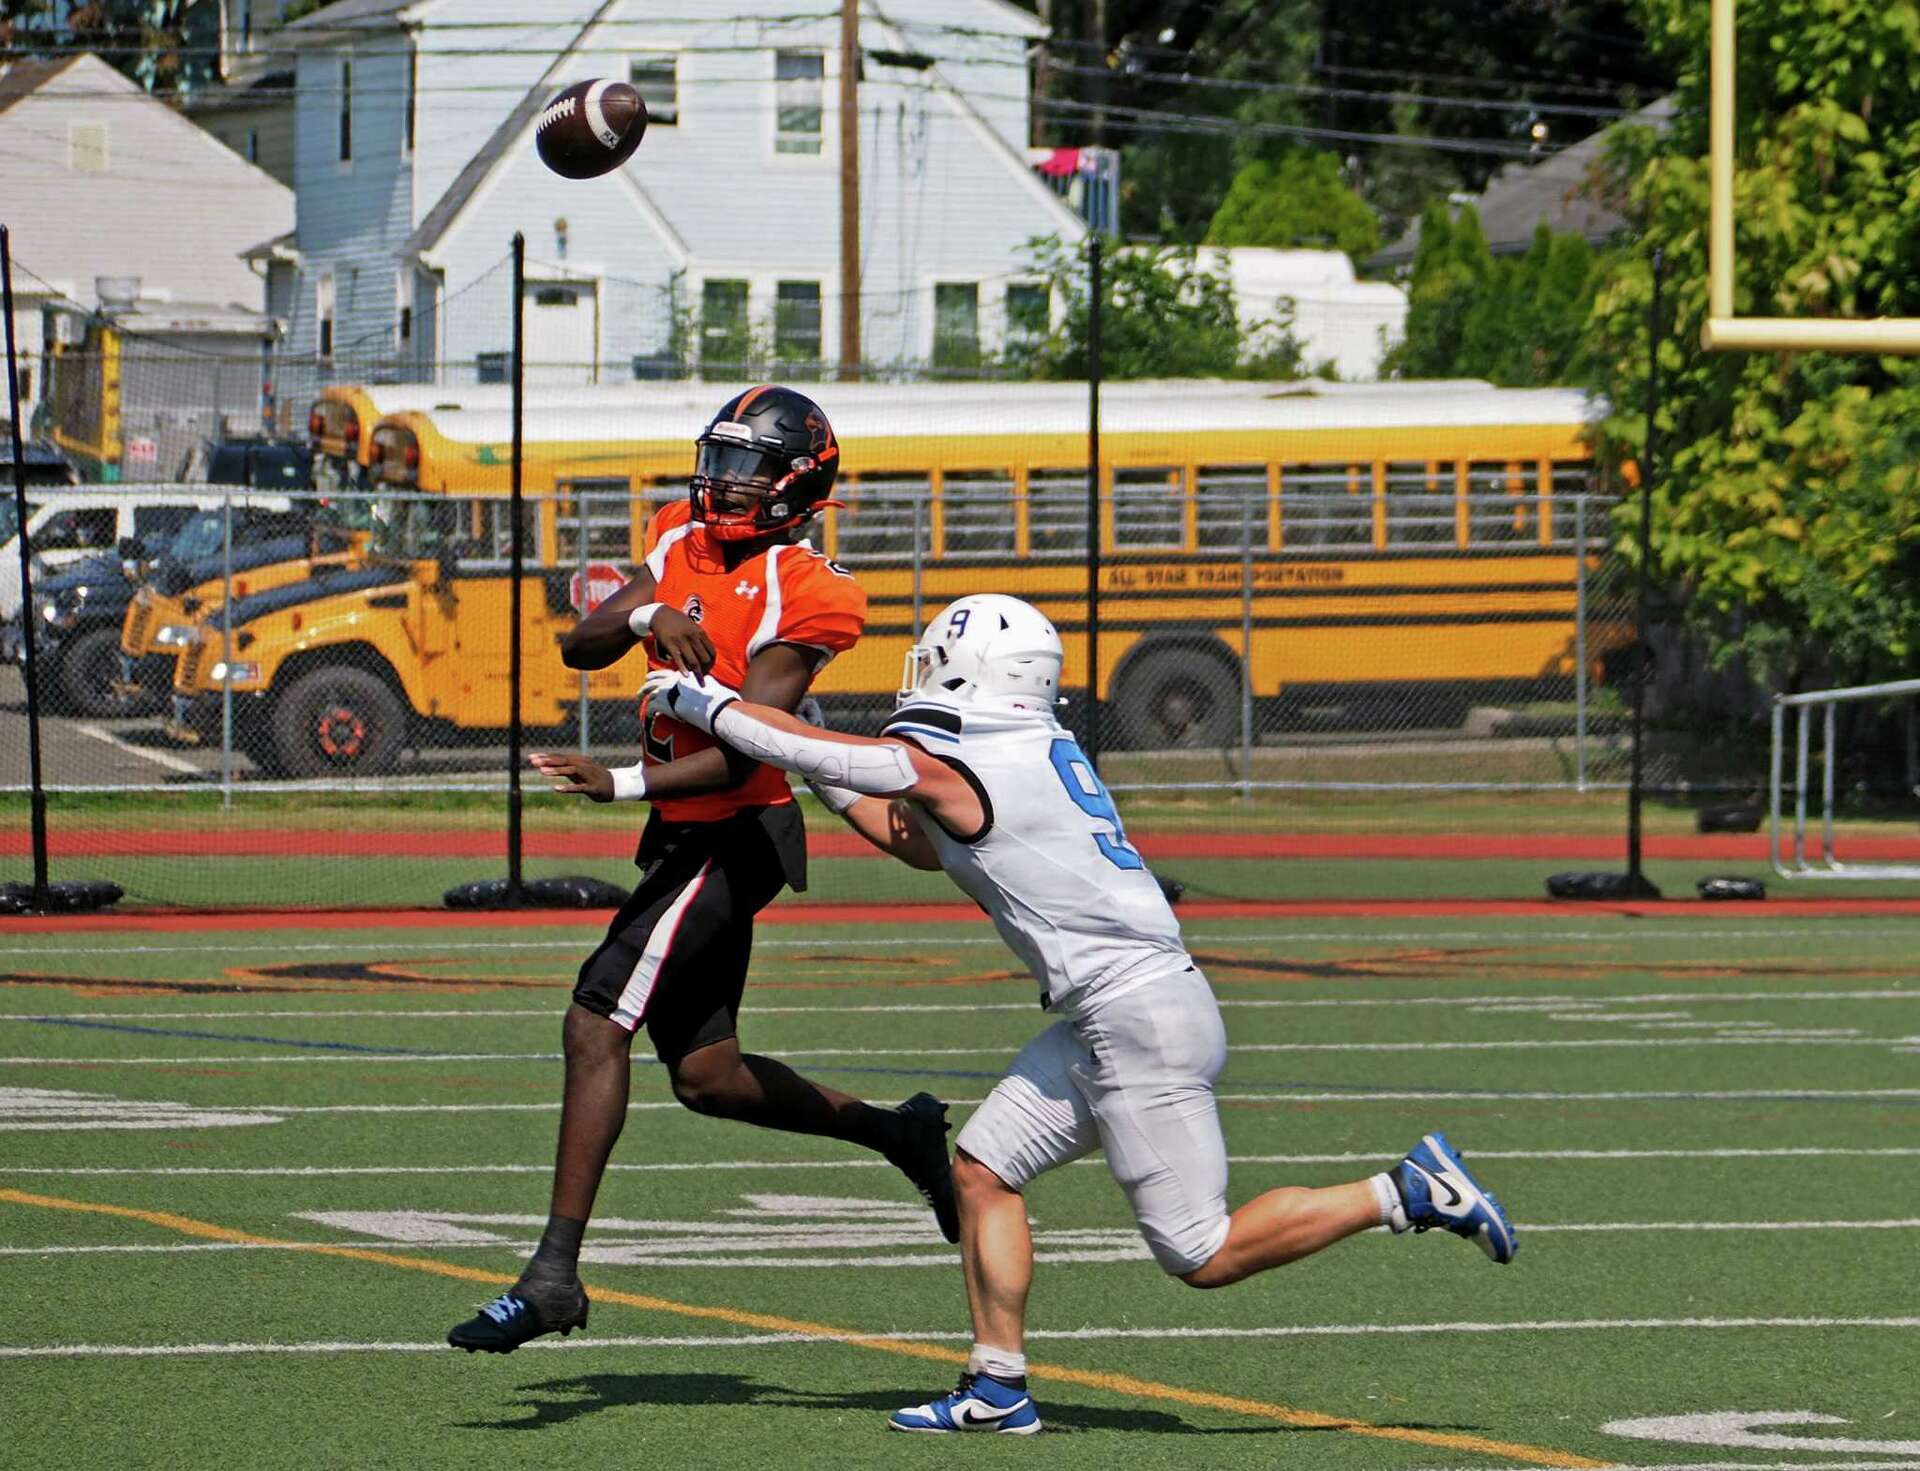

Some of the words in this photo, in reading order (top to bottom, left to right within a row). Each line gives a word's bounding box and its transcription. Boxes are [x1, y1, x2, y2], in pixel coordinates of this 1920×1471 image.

[1197, 566, 1344, 584] TRANPORTATION
[947, 609, 971, 639] 9
[1048, 737, 1144, 871] 9
